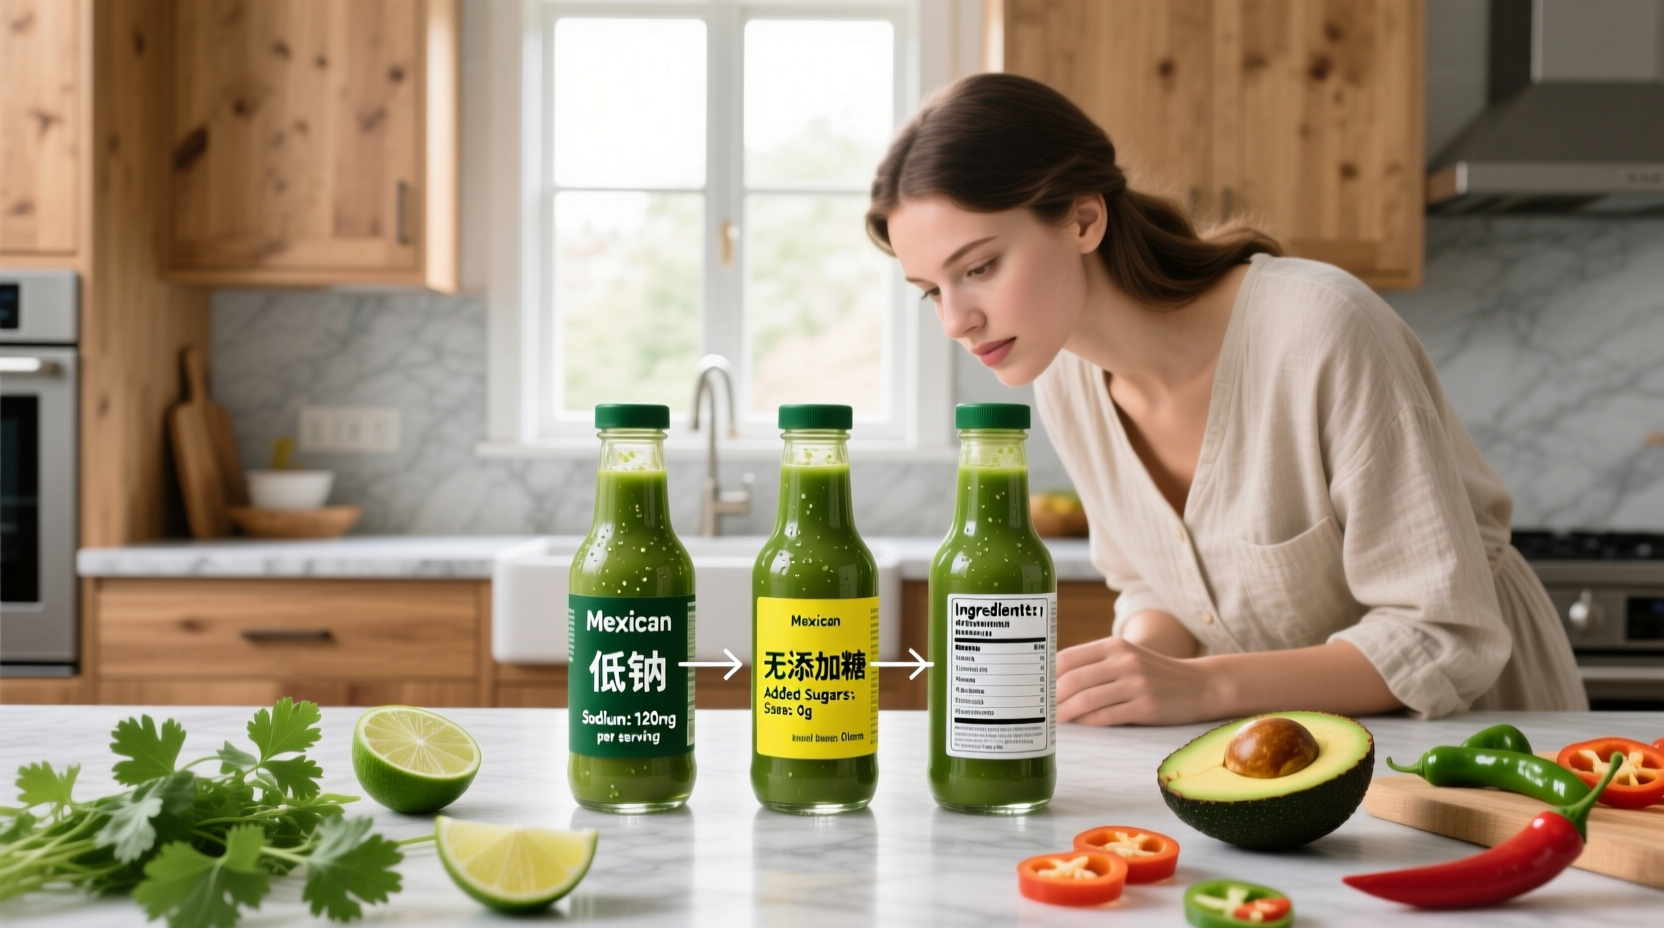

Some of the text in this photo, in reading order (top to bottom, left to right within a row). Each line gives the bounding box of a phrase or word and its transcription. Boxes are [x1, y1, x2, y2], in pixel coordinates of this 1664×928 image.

[586, 609, 672, 633] Mexican
[791, 614, 841, 627] Mexican
[589, 650, 667, 693] 低钠
[764, 649, 867, 682] 无添加糖
[764, 685, 856, 705] Added Sugars:
[797, 704, 813, 721] 0g
[597, 730, 661, 746] per serving
